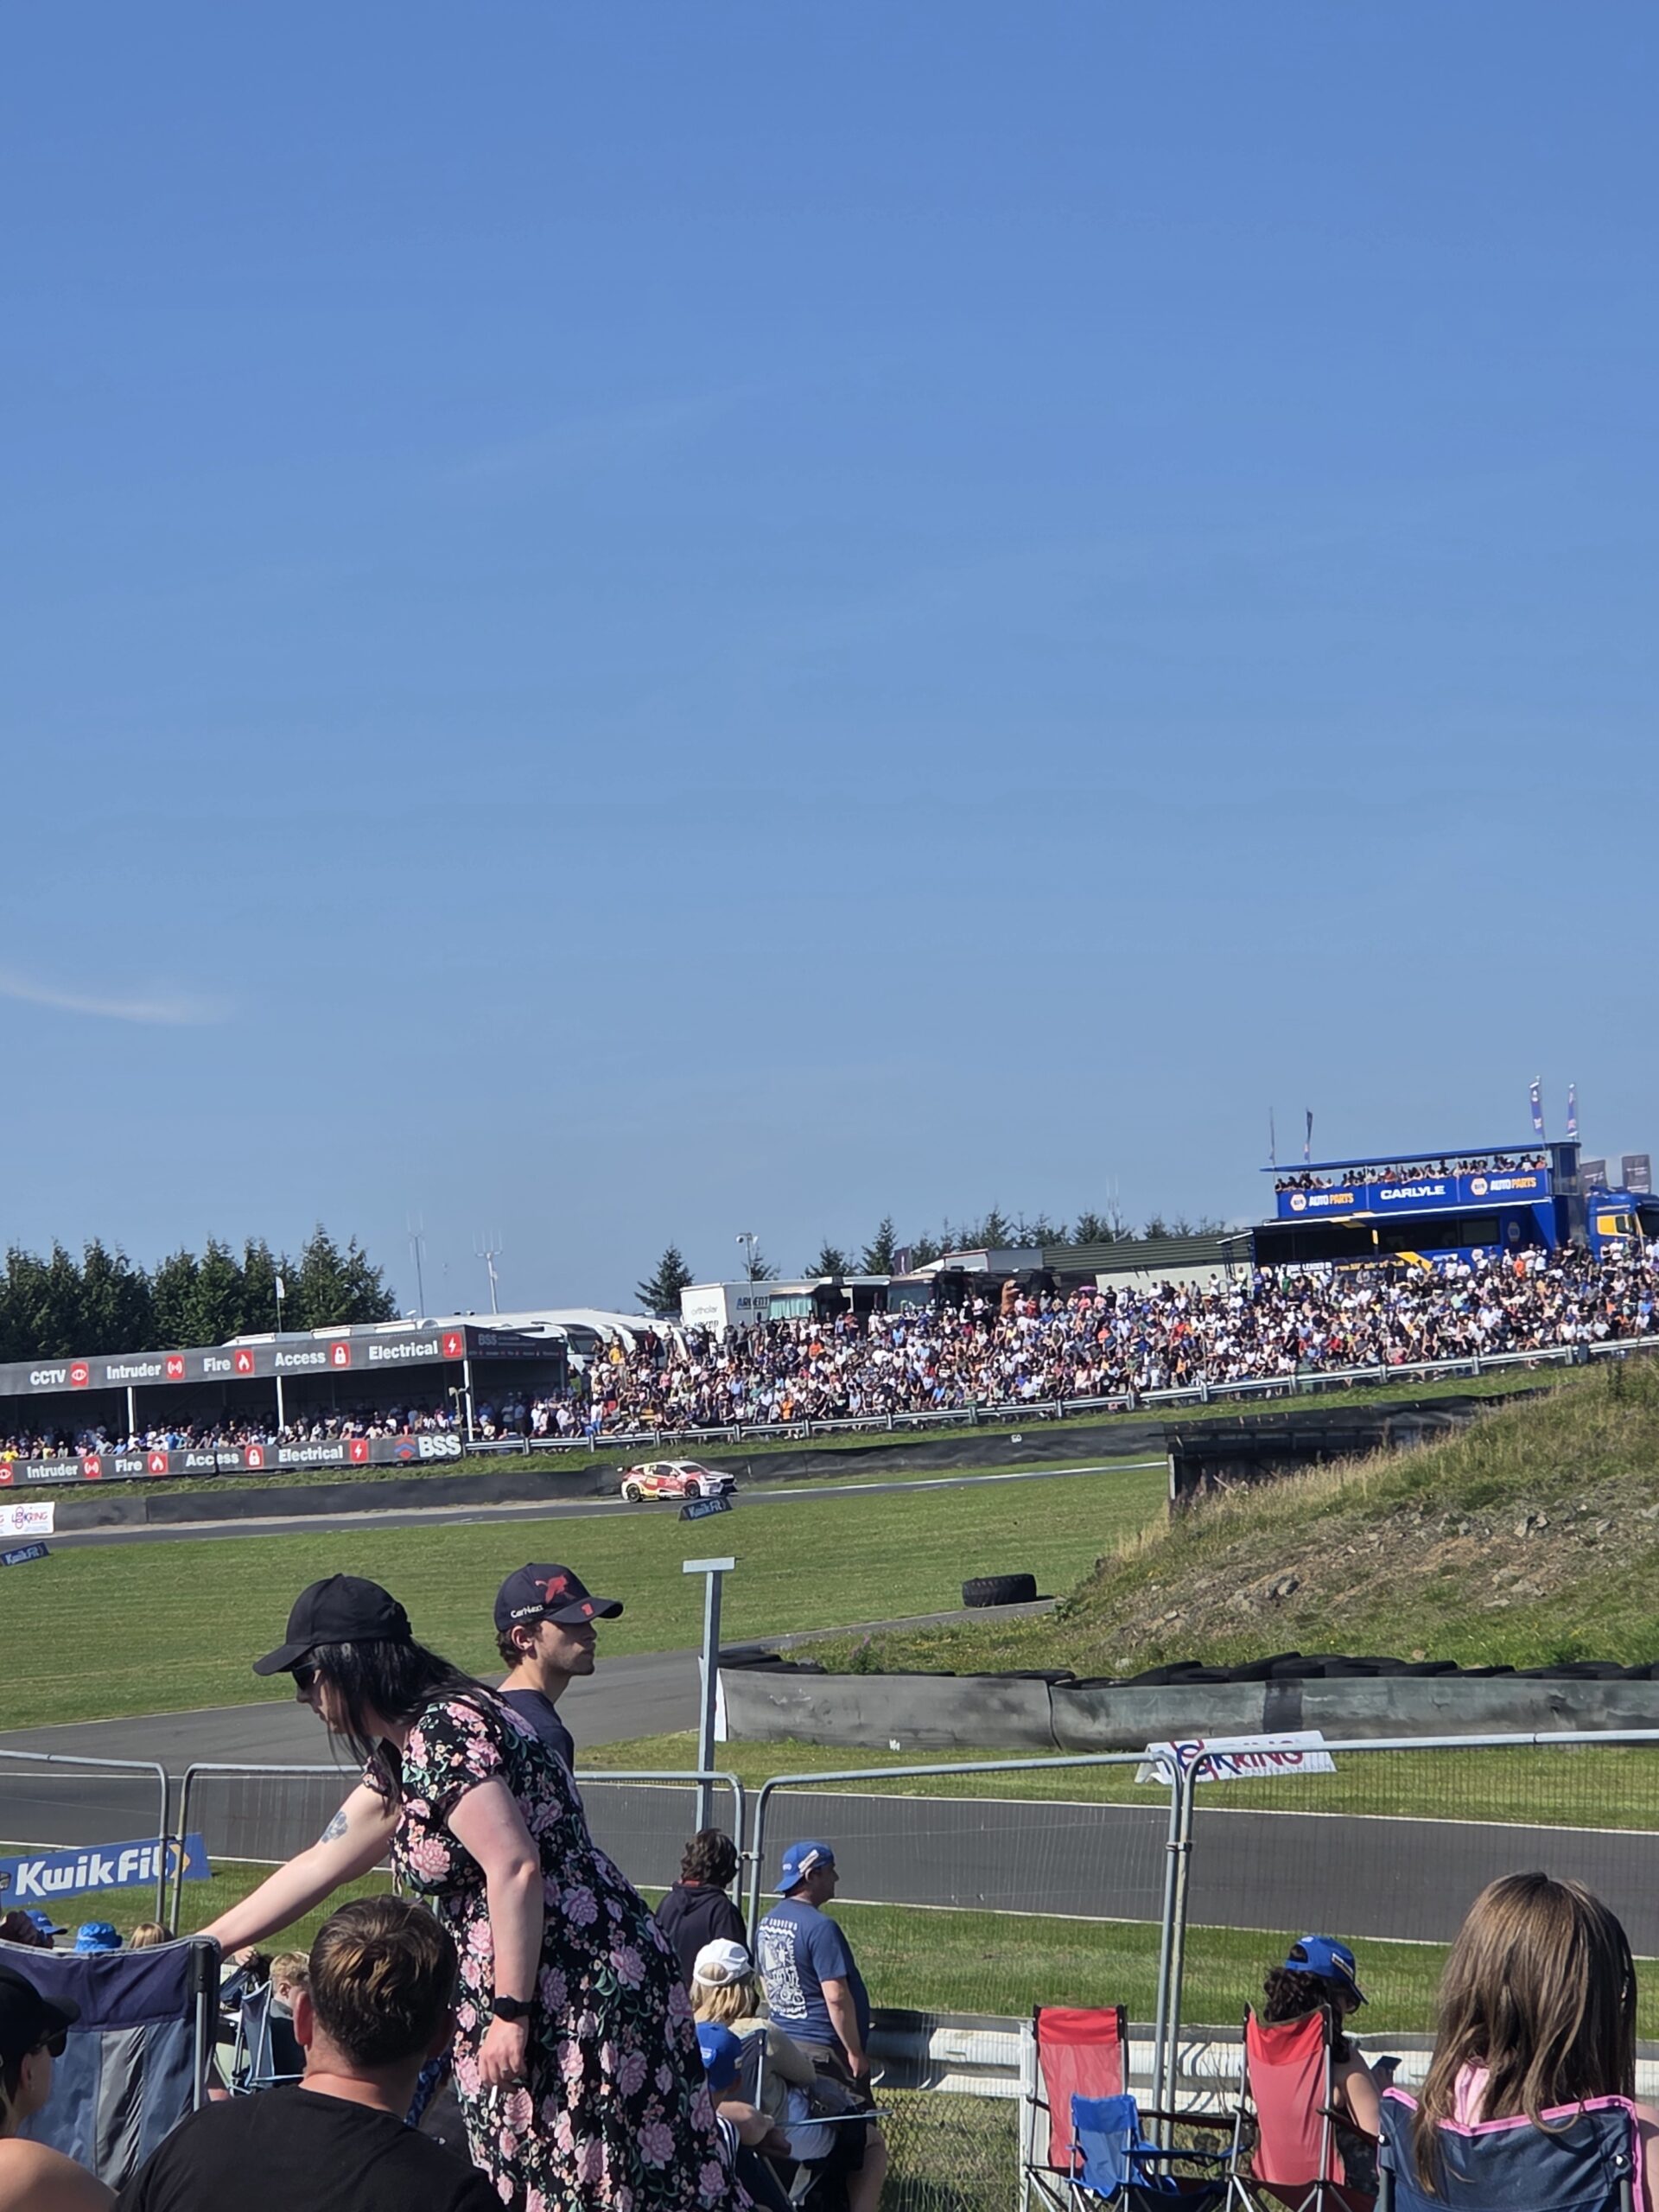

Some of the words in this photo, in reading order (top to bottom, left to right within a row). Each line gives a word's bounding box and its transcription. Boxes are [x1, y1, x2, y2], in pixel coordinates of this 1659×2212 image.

[1511, 1177, 1536, 1189] PARTS
[1329, 1192, 1354, 1205] PARTS
[1380, 1185, 1446, 1199] CARLYLE
[30, 1369, 66, 1385] CCTV
[106, 1363, 162, 1380] Intruder
[203, 1357, 232, 1372] Fire
[275, 1351, 326, 1367] Access
[369, 1340, 438, 1361] Electrical
[27, 1464, 78, 1478] Intruder
[115, 1459, 143, 1472] Fire
[186, 1452, 239, 1467] Access
[278, 1445, 343, 1463] Electrical
[418, 1434, 461, 1458] BSS
